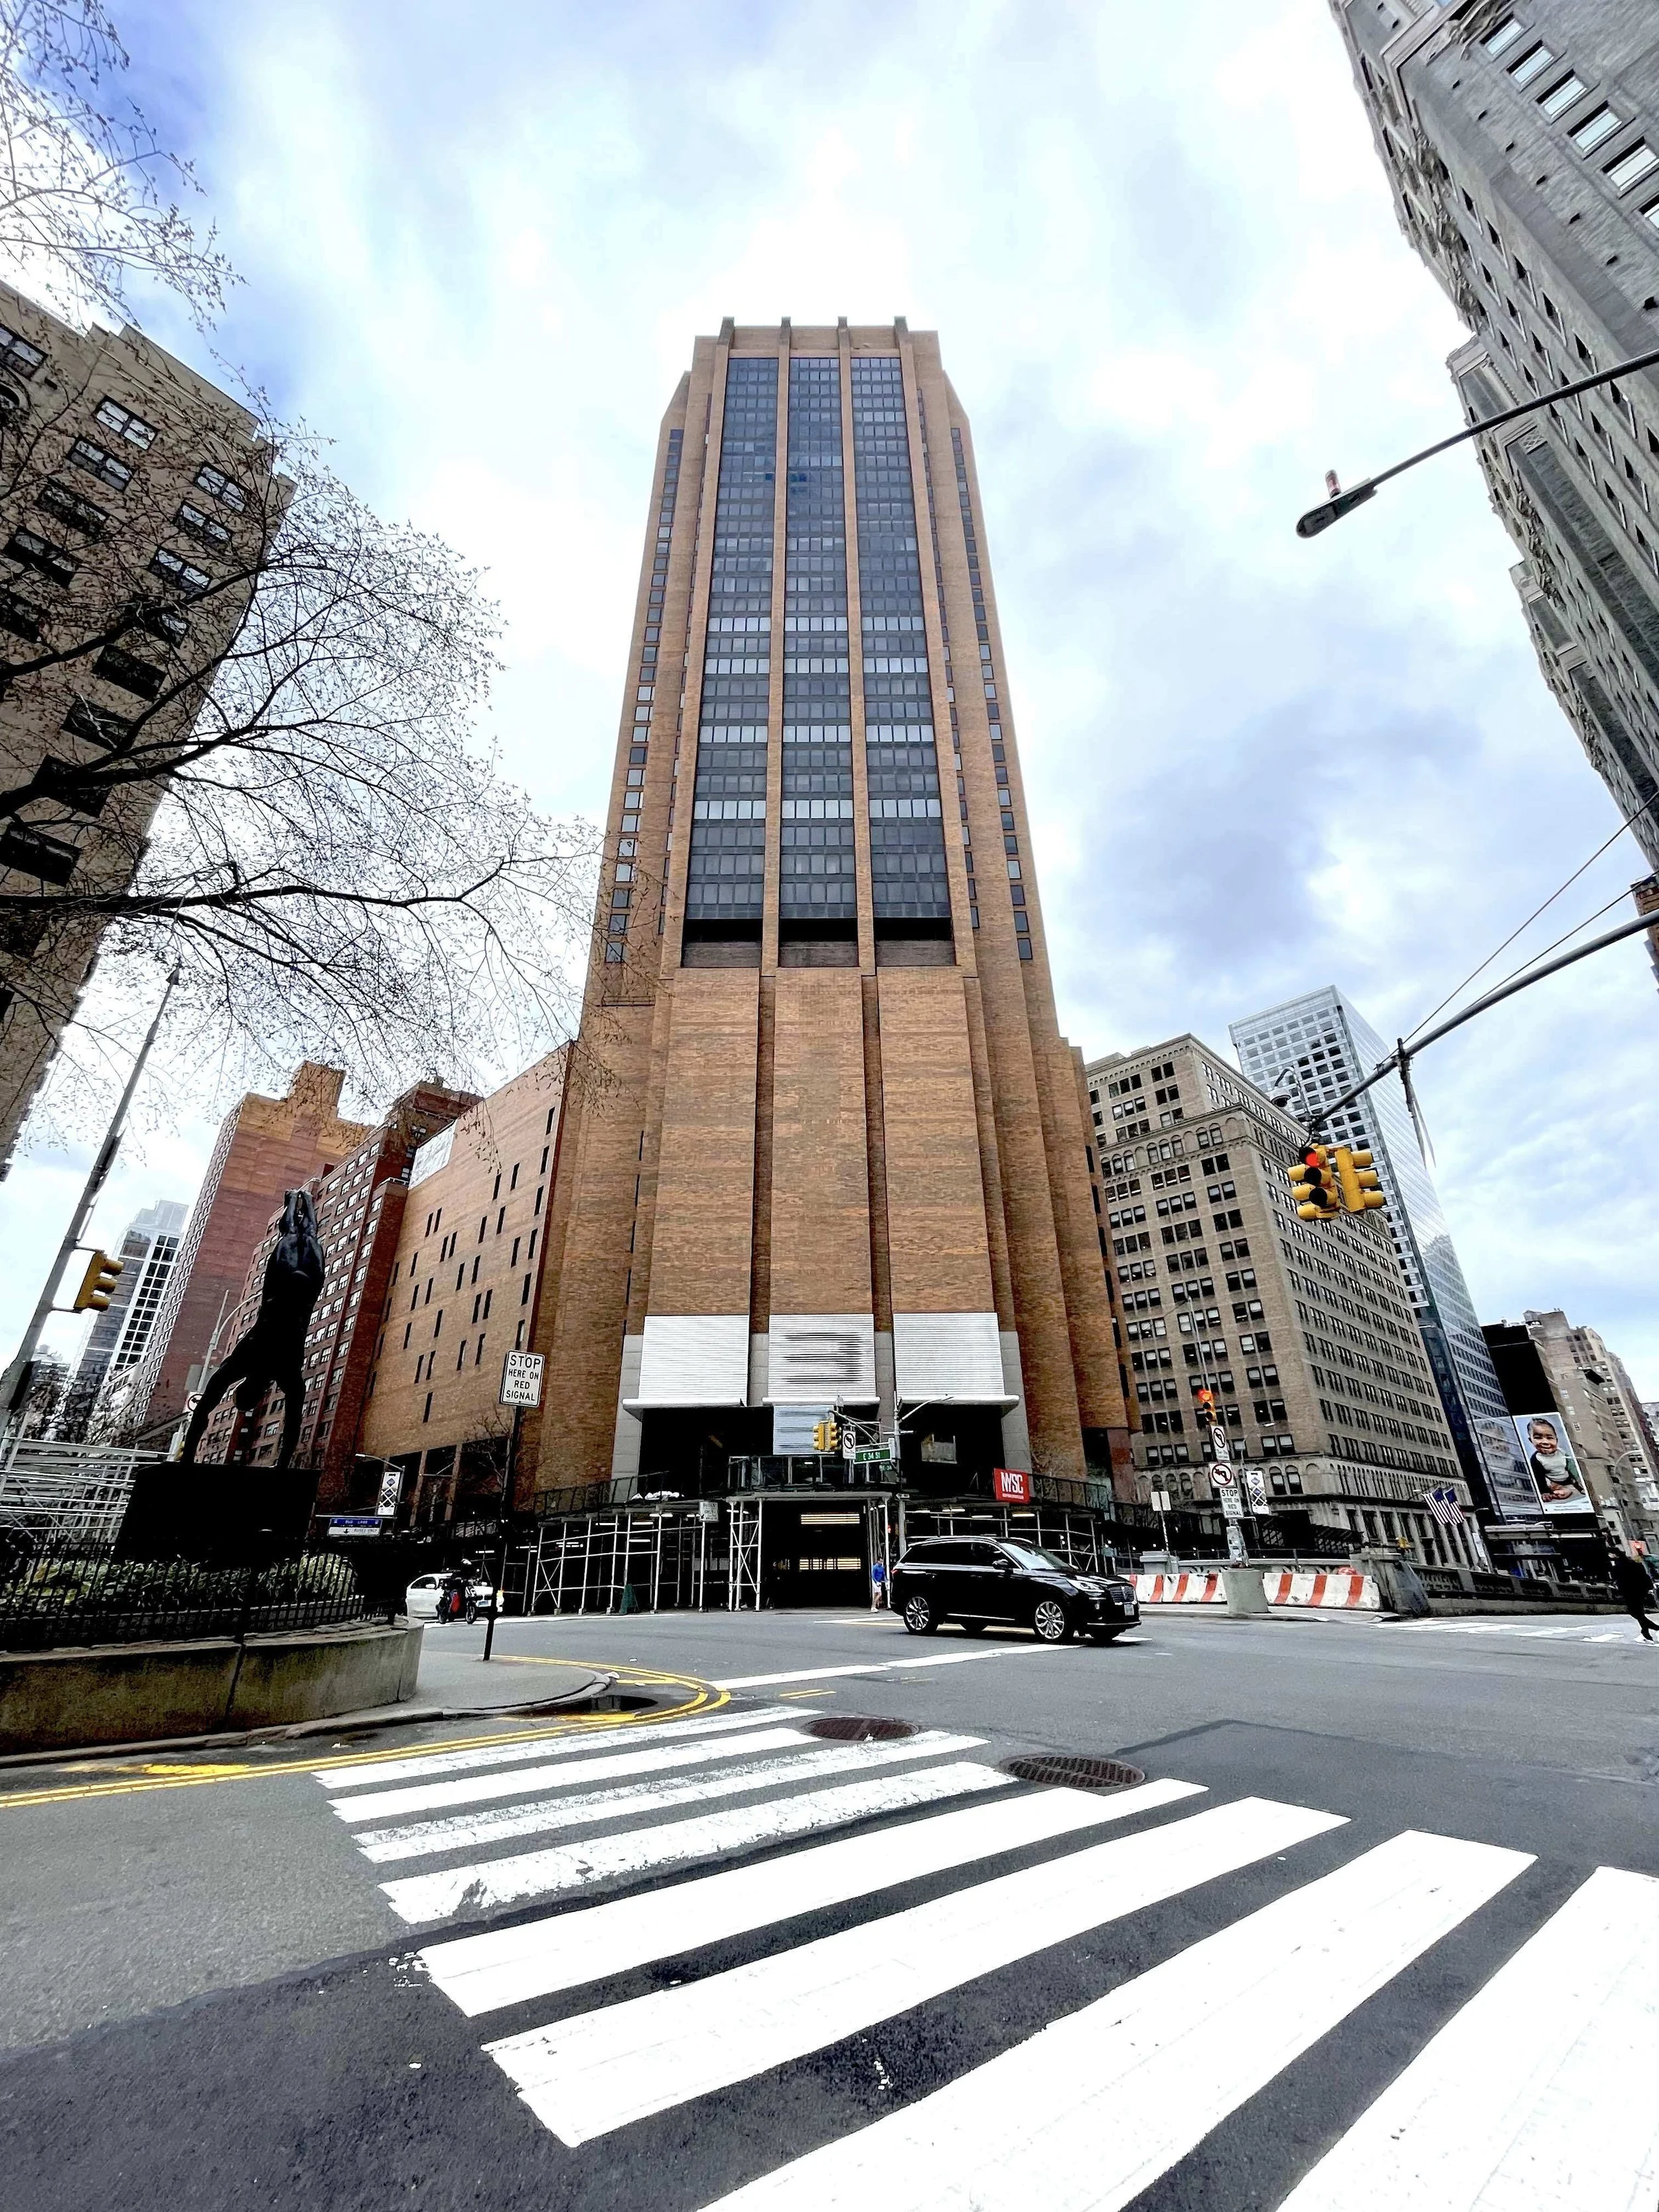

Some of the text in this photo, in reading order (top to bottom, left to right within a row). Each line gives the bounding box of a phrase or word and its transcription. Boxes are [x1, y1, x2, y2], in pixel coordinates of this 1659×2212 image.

[510, 1355, 541, 1369] STOP
[508, 1368, 539, 1380] HERE ON
[514, 1380, 530, 1389] RED
[506, 1390, 536, 1401] SIGNAL
[1001, 1471, 1024, 1494] NYSC
